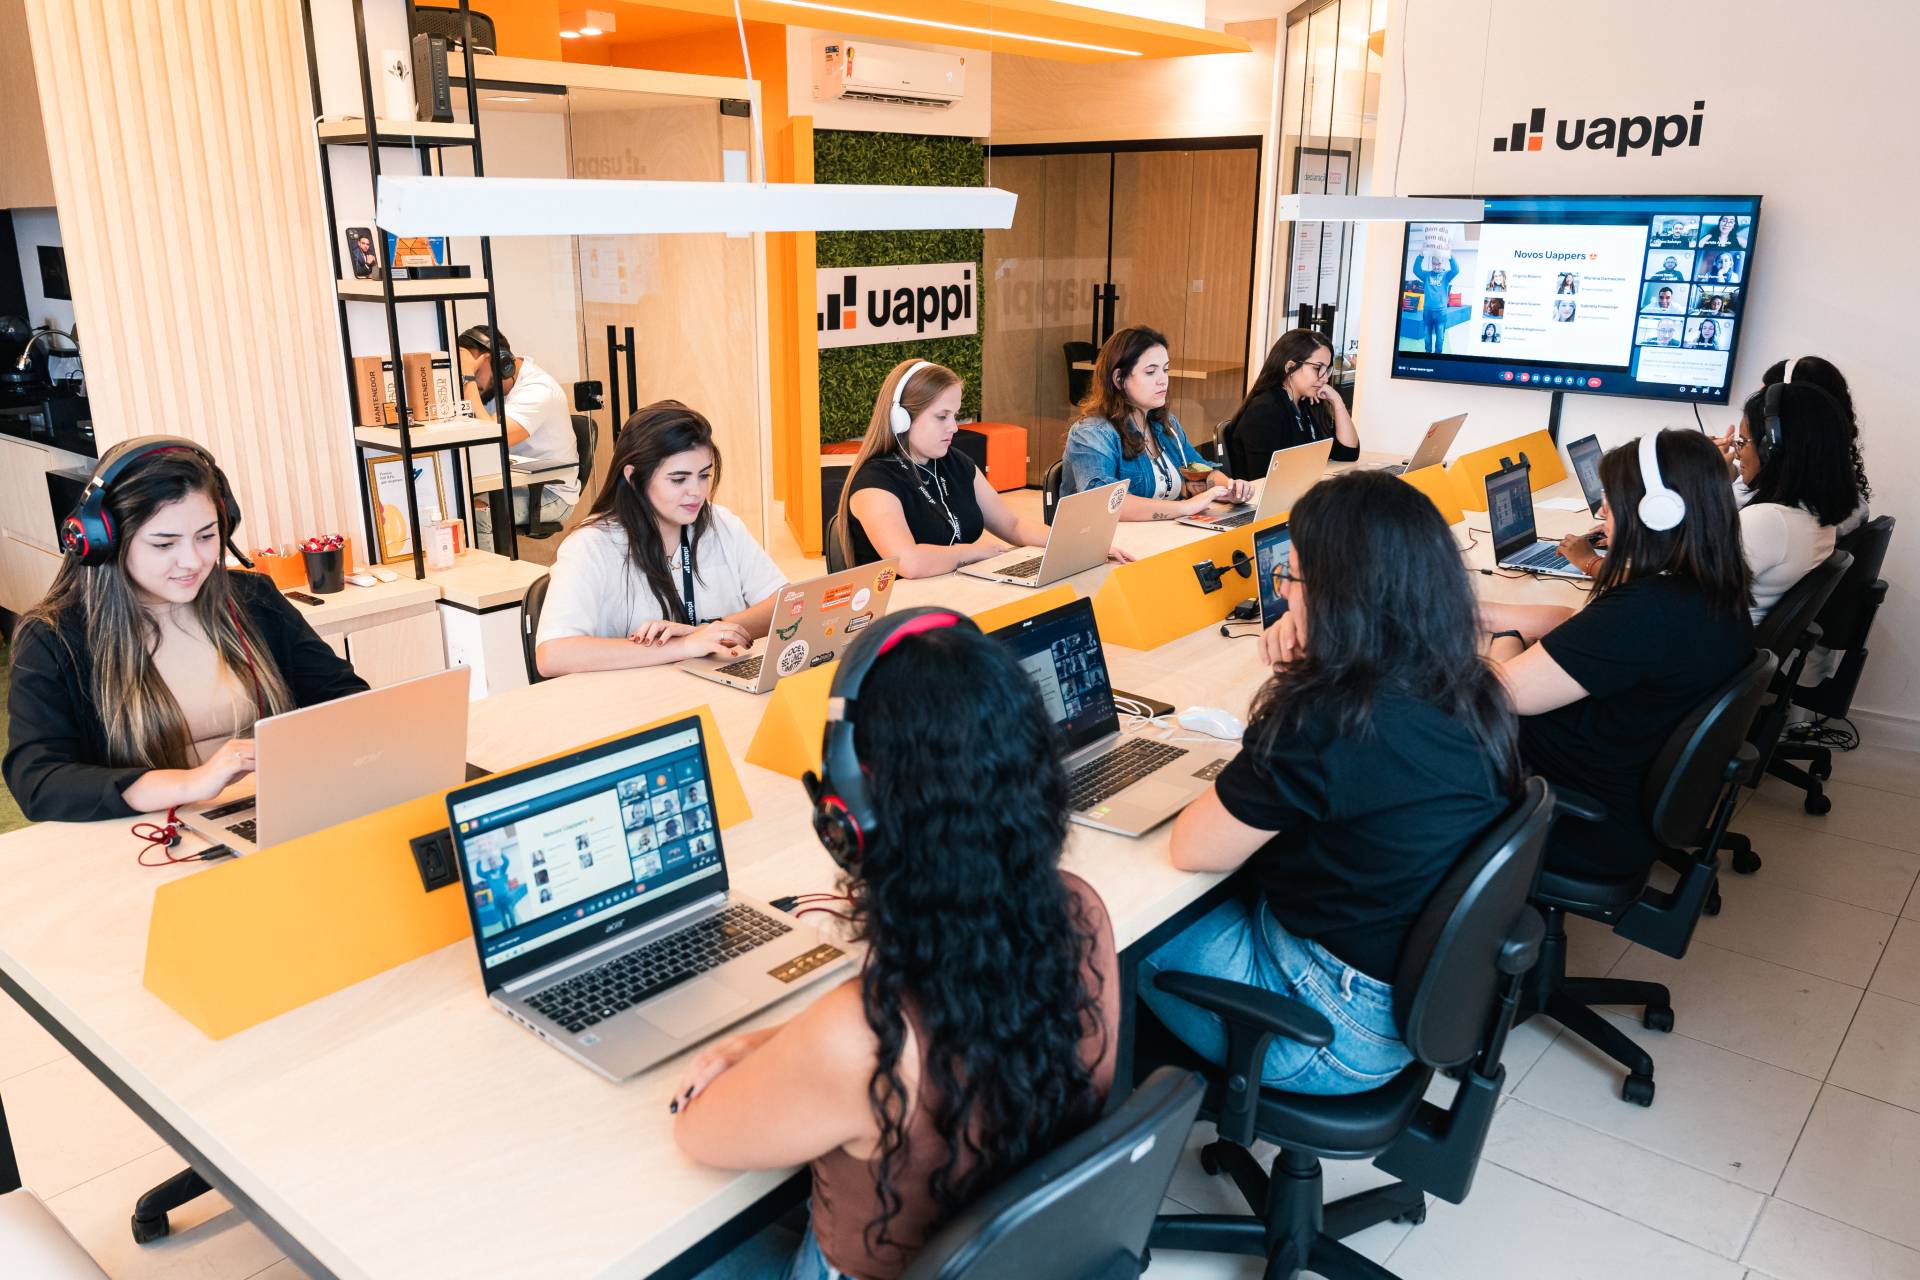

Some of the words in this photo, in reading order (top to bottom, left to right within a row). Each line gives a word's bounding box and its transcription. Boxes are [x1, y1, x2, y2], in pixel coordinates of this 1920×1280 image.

[1555, 100, 1705, 157] uappi
[1513, 249, 1544, 260] Novos
[1545, 251, 1587, 262] Uappers
[867, 269, 972, 333] uappi
[369, 371, 381, 423] MANTENEDOR
[420, 366, 429, 417] MANTENEDOR
[682, 546, 691, 566] uappi
[685, 602, 695, 621] uappi
